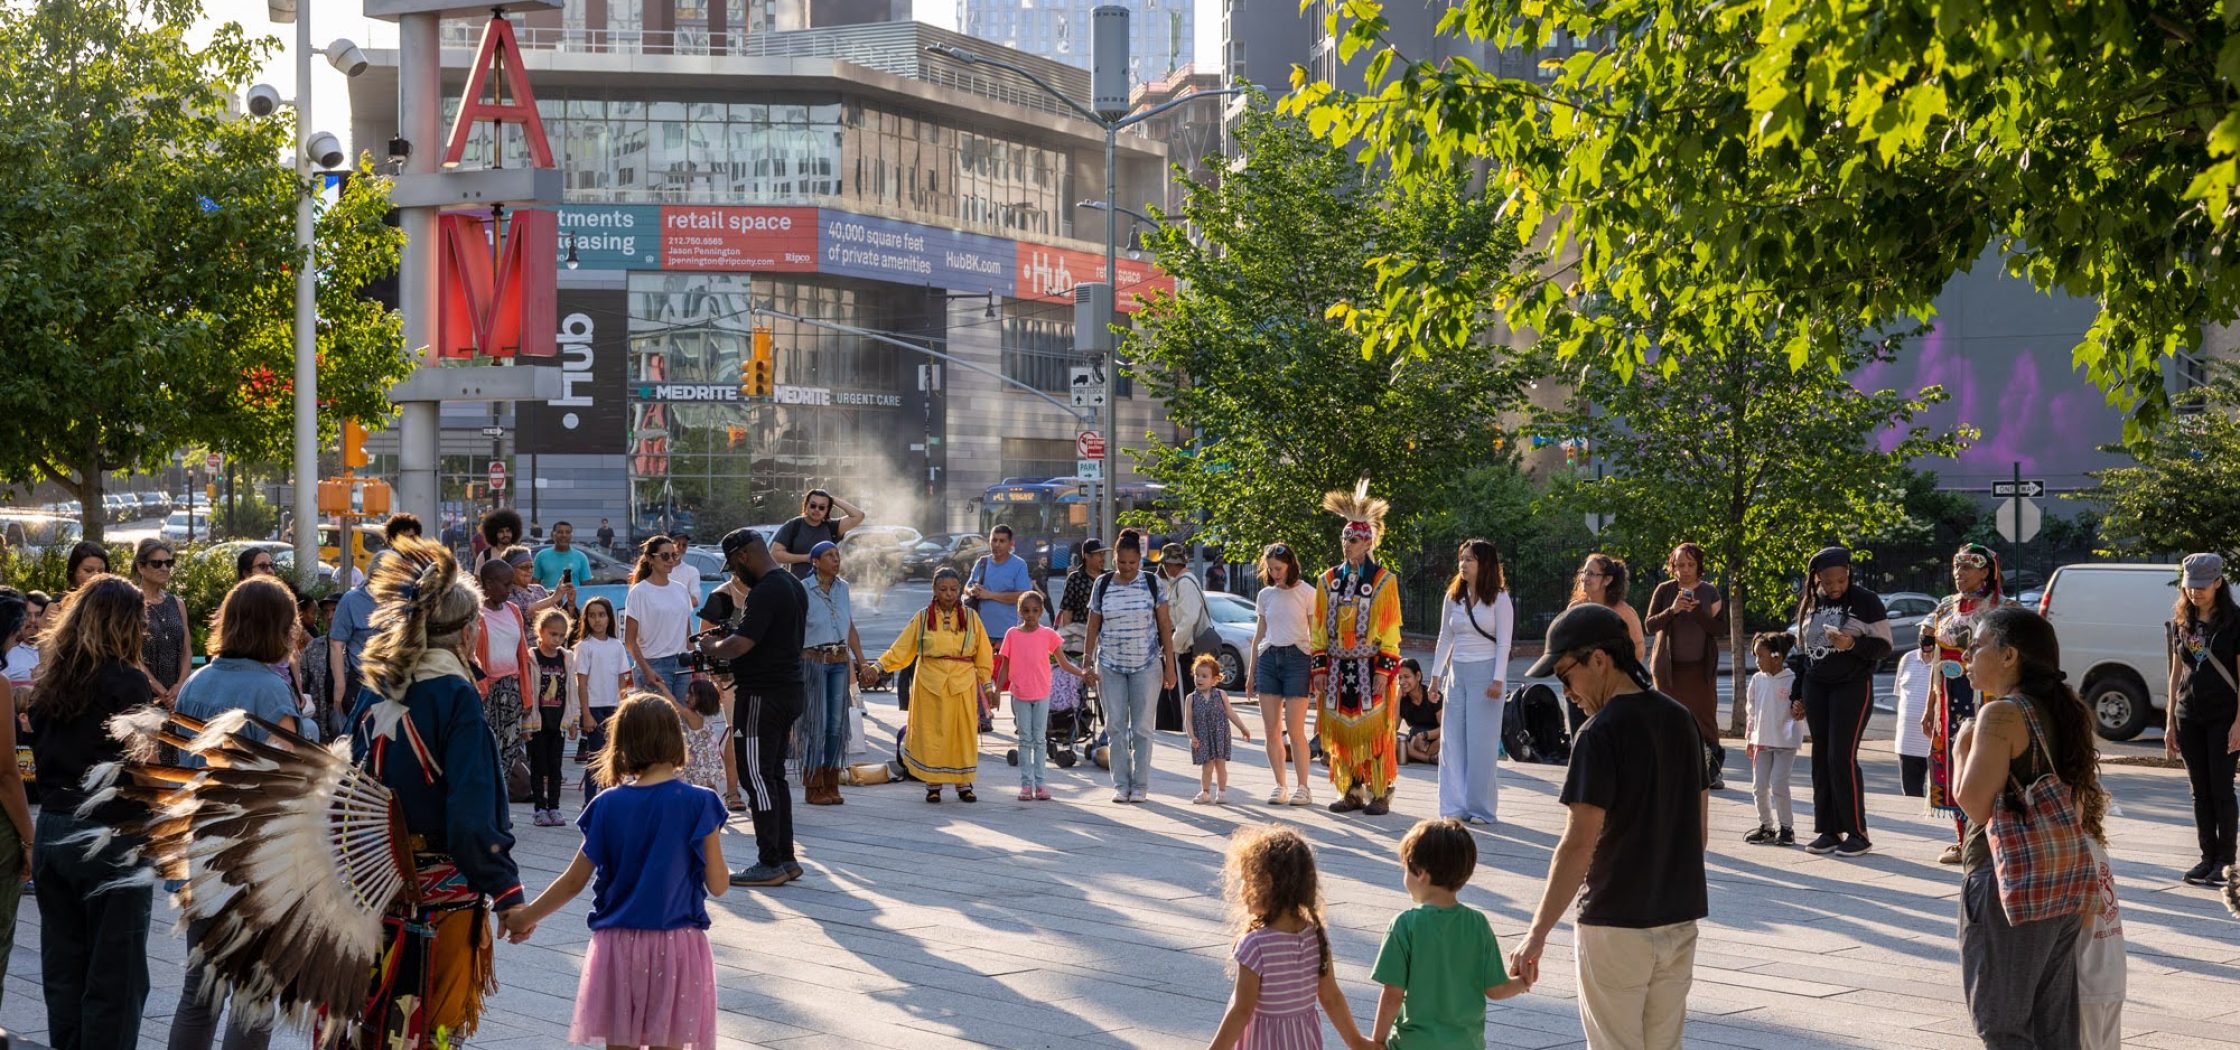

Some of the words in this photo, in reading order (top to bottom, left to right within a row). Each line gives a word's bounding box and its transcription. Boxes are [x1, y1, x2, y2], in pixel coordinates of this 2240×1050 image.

[557, 209, 634, 227] tments
[667, 211, 724, 229] retail
[729, 215, 792, 234] space
[828, 221, 865, 242] 40,000
[866, 229, 902, 250] square
[904, 233, 925, 252] feet
[668, 246, 692, 254] Jason
[694, 247, 740, 257] Pennington
[828, 243, 841, 260] of
[841, 246, 879, 266] private
[881, 253, 932, 275] amenities
[945, 250, 1001, 275] HubBK.com
[1033, 251, 1073, 298] Hub
[1118, 269, 1141, 285] space
[655, 384, 738, 401] MEDRITE
[773, 385, 831, 406] MEDRITE
[836, 392, 875, 405] URGENT
[877, 395, 901, 407] CARE
[1080, 462, 1097, 472] PARK
